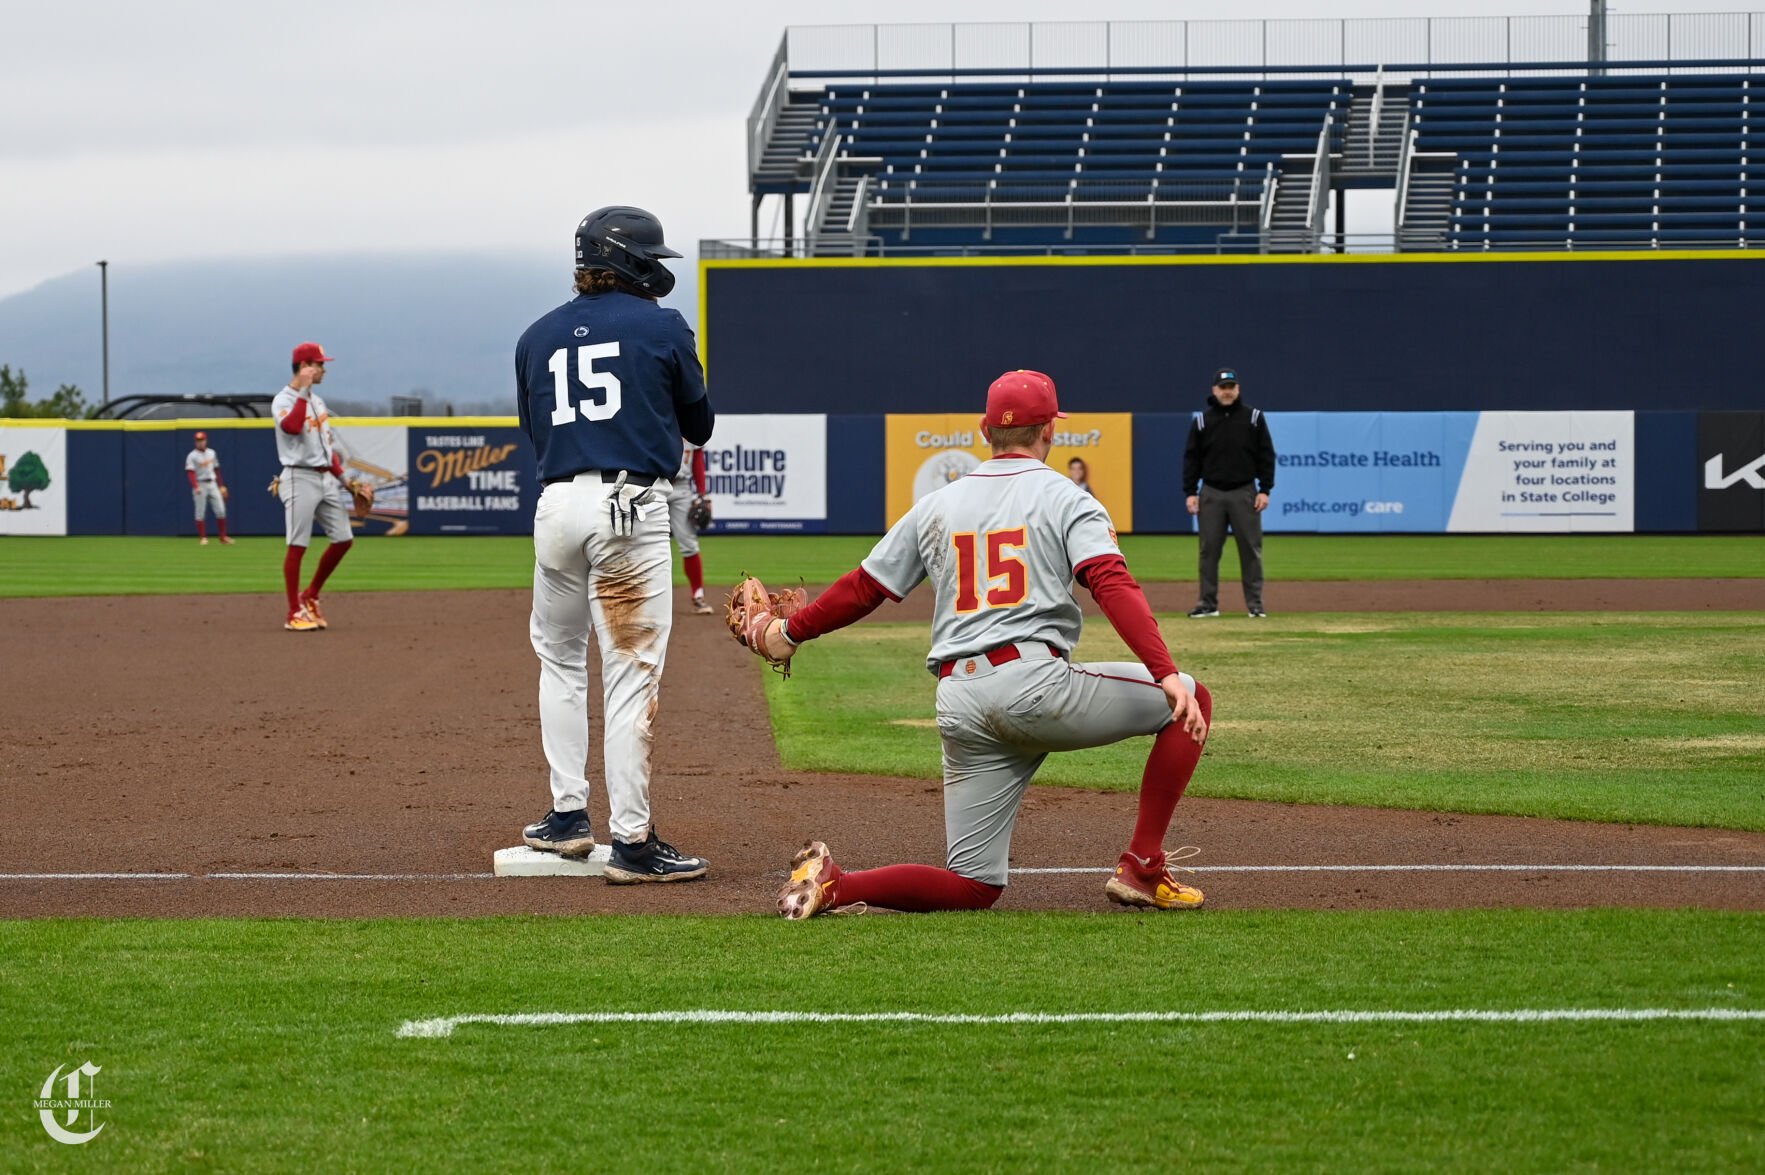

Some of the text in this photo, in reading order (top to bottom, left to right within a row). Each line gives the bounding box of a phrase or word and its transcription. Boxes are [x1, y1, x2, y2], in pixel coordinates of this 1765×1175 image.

[548, 341, 622, 426] 15
[915, 430, 975, 447] Could
[1052, 429, 1102, 447] ster?
[1498, 440, 1616, 454] Serving you and
[416, 443, 518, 488] Miller
[1277, 451, 1441, 467] ennState Health
[1514, 457, 1616, 471] your family at
[467, 471, 520, 493] TIME,
[1516, 474, 1616, 485] four locations
[417, 496, 520, 510] BASEBALL FANS
[1502, 491, 1616, 505] in State College
[1283, 498, 1404, 516] pshcc.org/care
[951, 524, 1029, 614] 15
